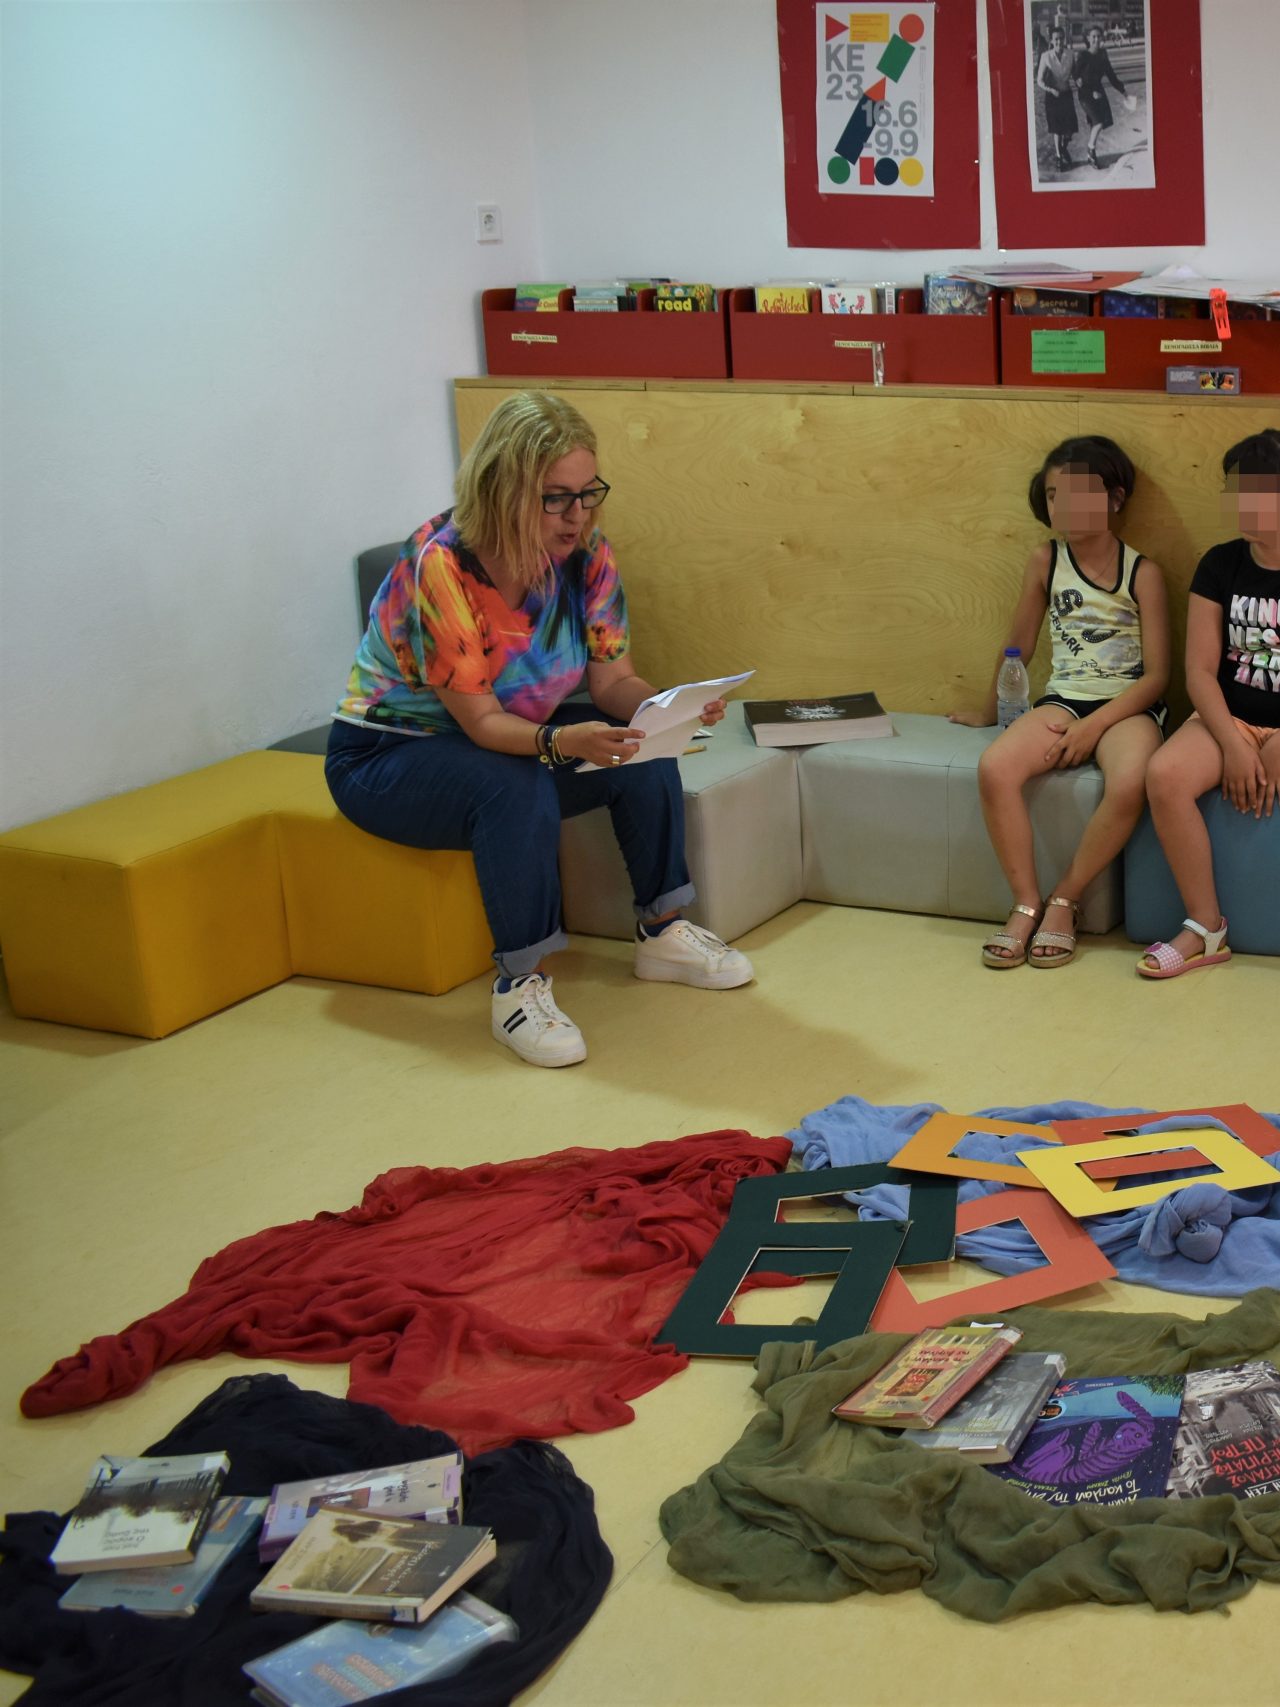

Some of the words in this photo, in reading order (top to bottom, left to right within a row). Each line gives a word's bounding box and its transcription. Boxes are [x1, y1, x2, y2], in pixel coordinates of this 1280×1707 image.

[825, 44, 865, 72] KE
[826, 73, 864, 100] 23
[862, 100, 918, 128] 16.6
[658, 298, 692, 312] read
[1211, 1436, 1266, 1464] ΠΕΤΡΟΥ
